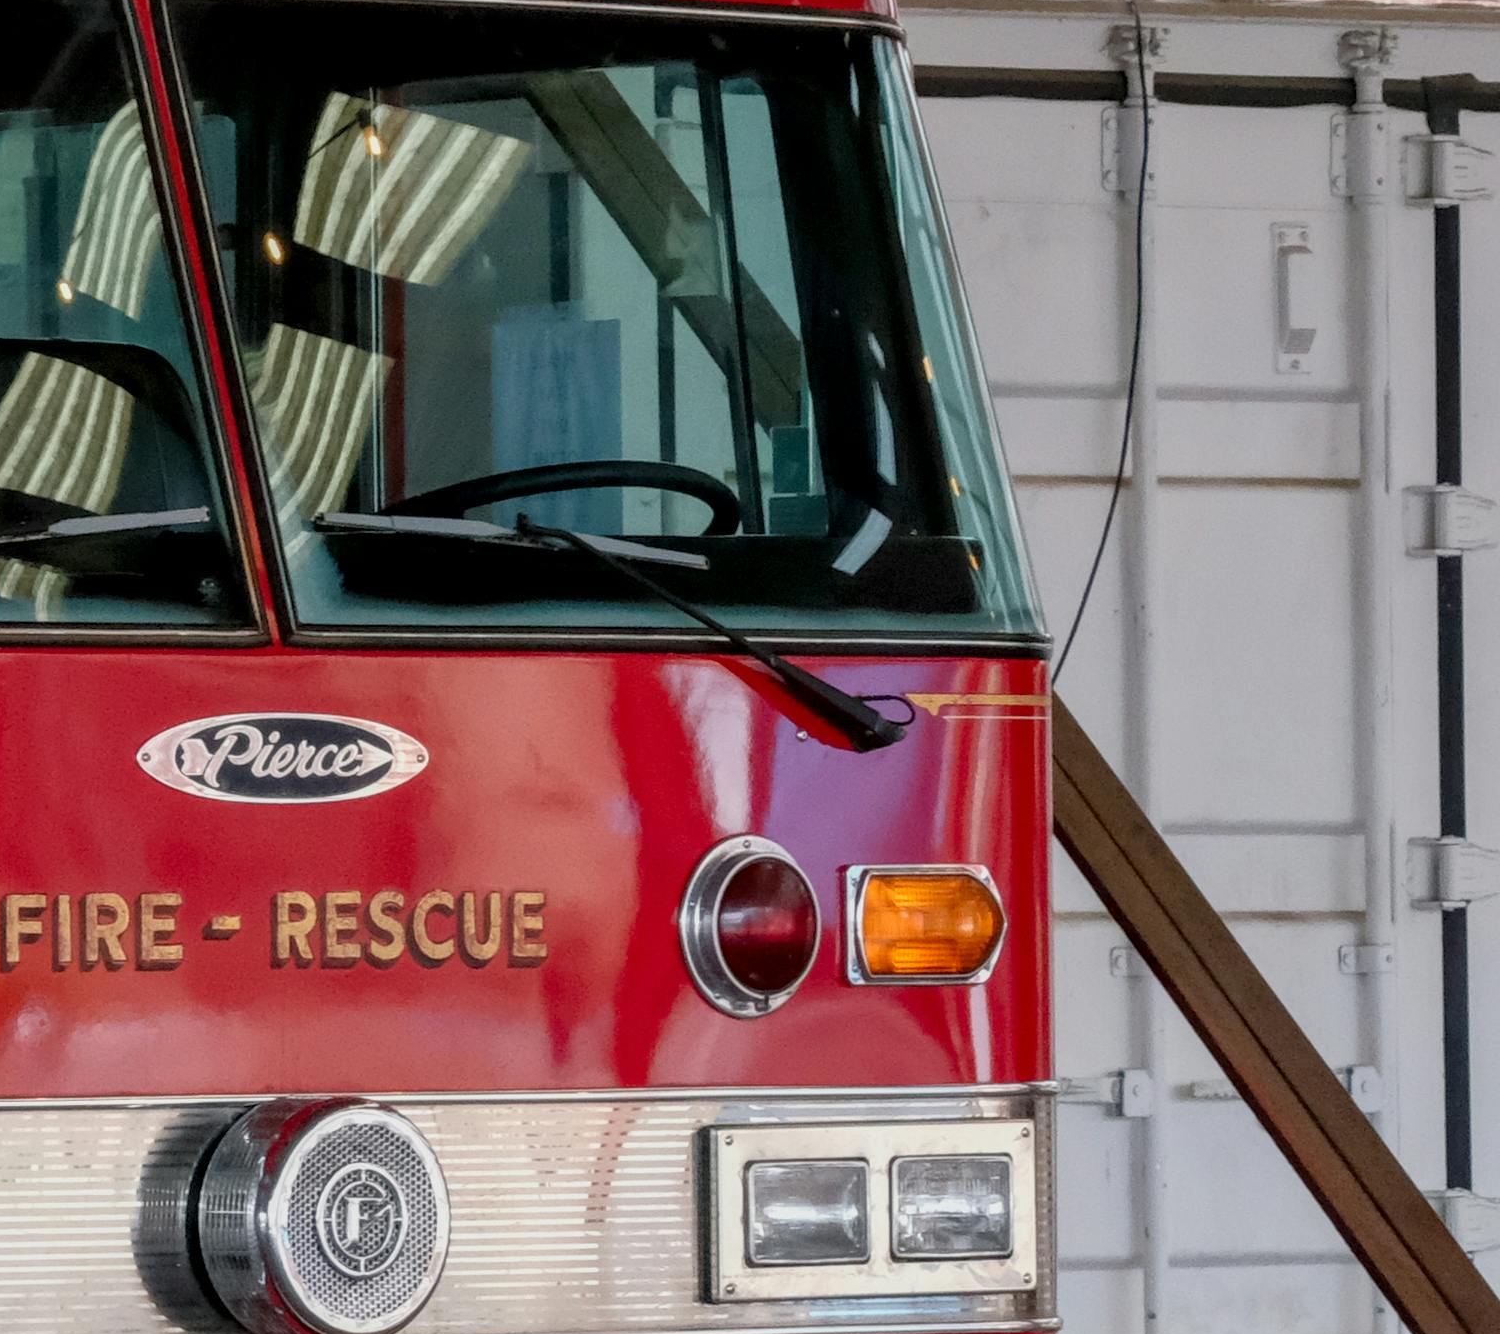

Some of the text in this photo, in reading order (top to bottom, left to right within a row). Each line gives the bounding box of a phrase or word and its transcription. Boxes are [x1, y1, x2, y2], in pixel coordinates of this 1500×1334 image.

[203, 724, 363, 788] Pierce
[4, 893, 184, 964] FIRE
[275, 890, 549, 962] RESCUE
